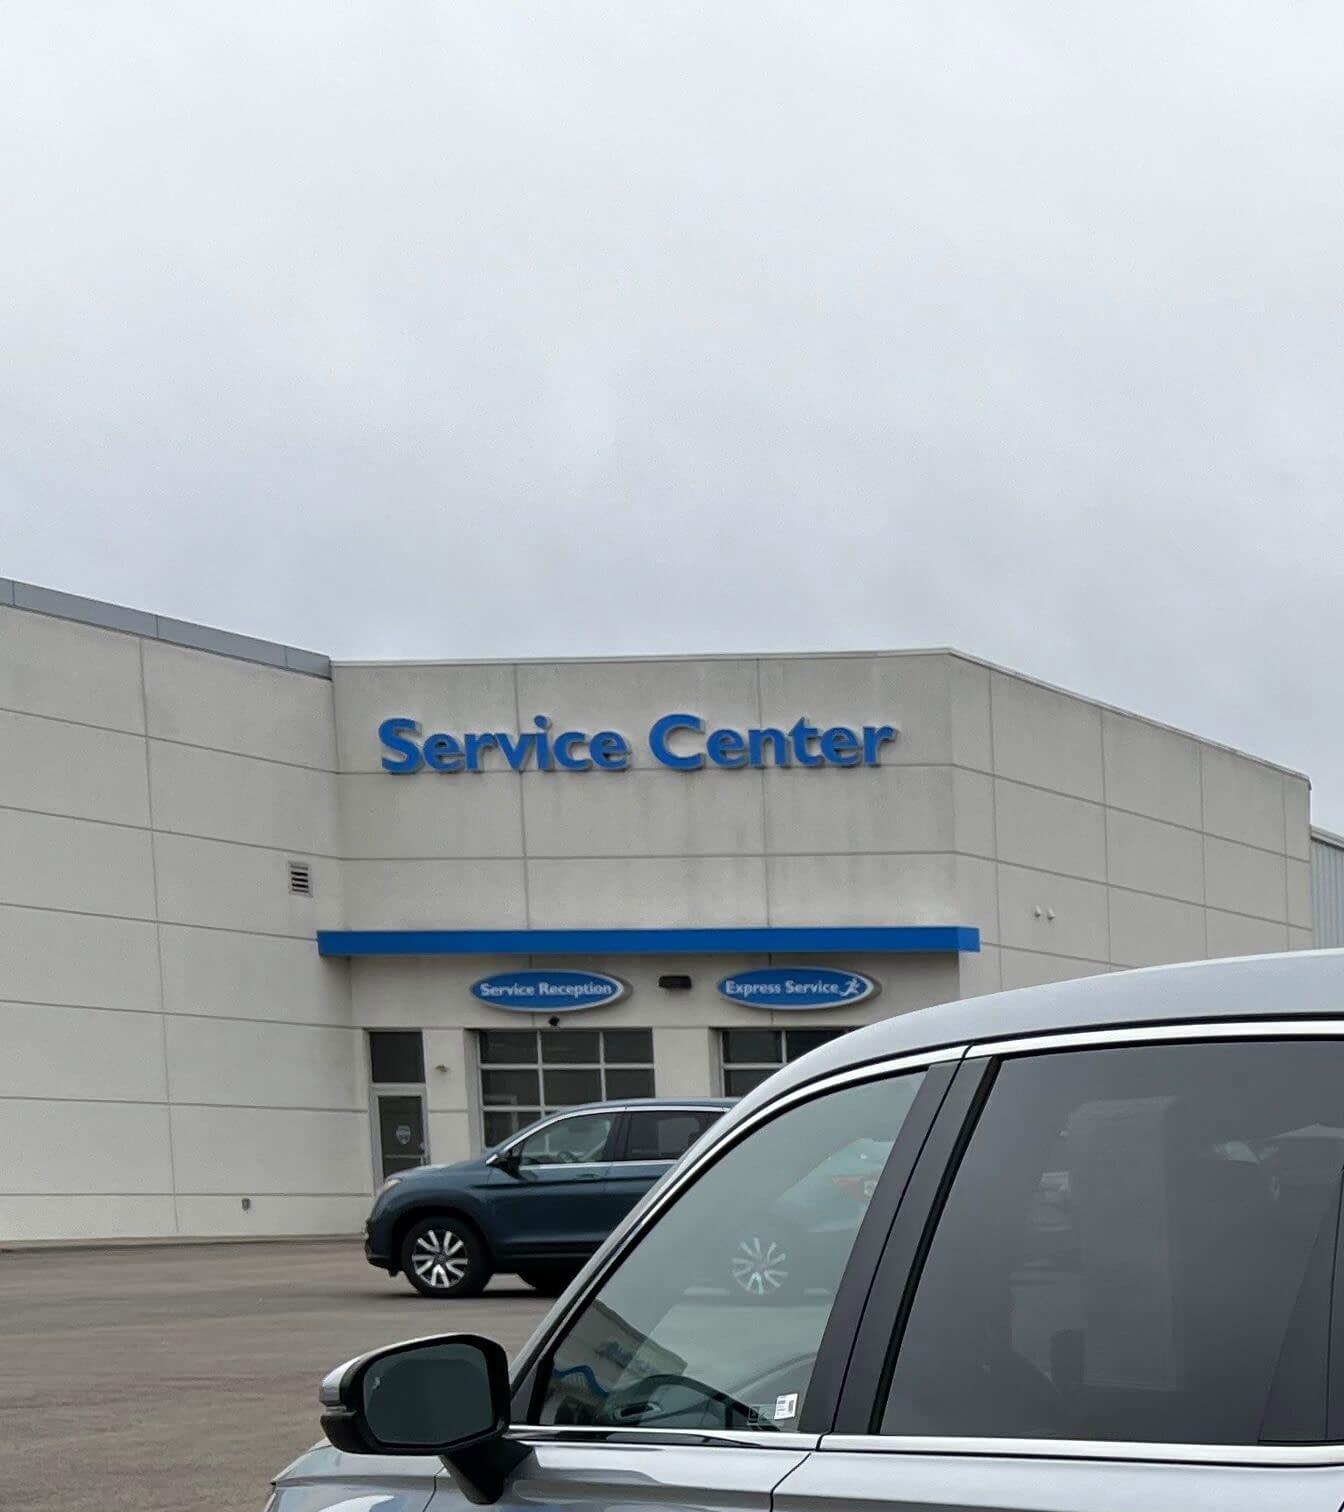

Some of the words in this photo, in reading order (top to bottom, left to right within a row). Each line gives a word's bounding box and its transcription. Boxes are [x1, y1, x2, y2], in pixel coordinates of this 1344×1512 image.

[378, 715, 631, 775] Service
[648, 714, 898, 771] Center
[479, 982, 535, 997] Service
[538, 981, 612, 999] Reception
[725, 980, 781, 997] Express
[784, 980, 839, 994] Service
